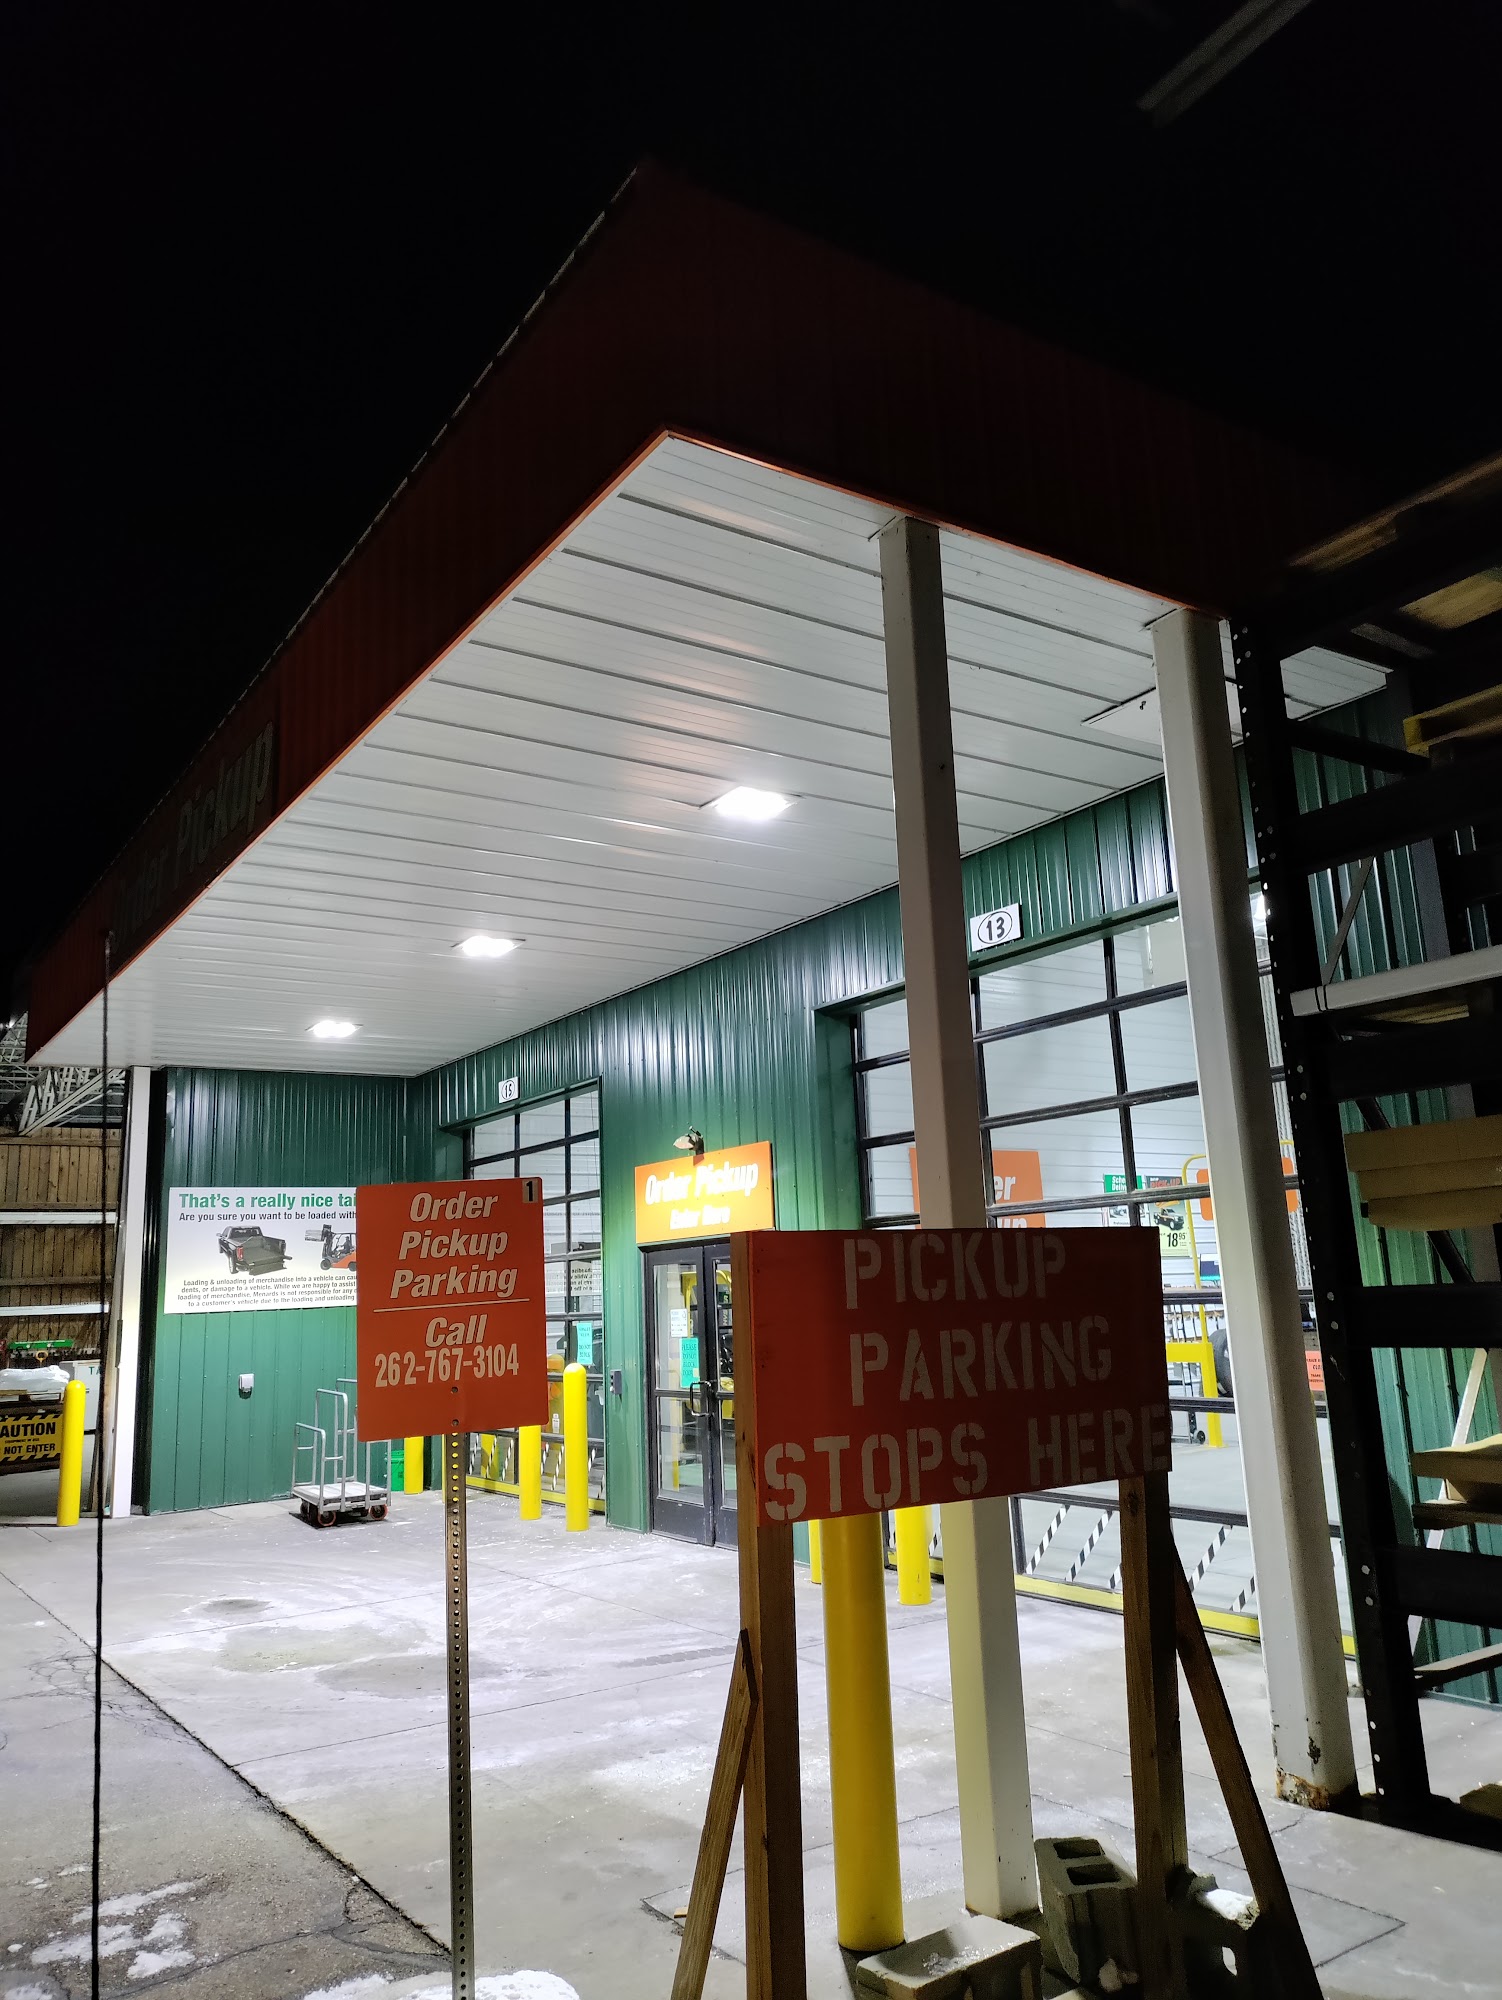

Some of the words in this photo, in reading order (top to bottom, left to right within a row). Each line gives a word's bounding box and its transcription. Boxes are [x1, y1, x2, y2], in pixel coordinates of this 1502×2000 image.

[986, 916, 1005, 941] 13
[525, 1181, 533, 1202] 1
[645, 1171, 692, 1205] Order
[695, 1161, 759, 1197] Pickup
[179, 1193, 230, 1208] That's
[236, 1196, 245, 1207] a
[251, 1193, 296, 1210] really
[301, 1193, 333, 1207] nice
[338, 1193, 357, 1207] tai
[179, 1213, 195, 1221] Are
[198, 1214, 214, 1222] you
[240, 1213, 256, 1222] you
[259, 1212, 281, 1220] want
[284, 1212, 292, 1220] to
[308, 1211, 336, 1219] loaded
[339, 1211, 357, 1219] with
[410, 1191, 499, 1222] Order
[398, 1228, 508, 1261] Pickup
[1167, 1233, 1178, 1247] 18
[390, 1265, 518, 1299] Parking
[844, 1231, 1066, 1309] PICKUP
[425, 1314, 488, 1348] Call
[375, 1343, 519, 1388] 262-767-3104
[849, 1314, 1113, 1407] PARKING
[0, 1422, 56, 1438] AUTION
[4, 1445, 23, 1454] NOT
[26, 1443, 55, 1453] ENTER
[764, 1422, 988, 1521] STOPS
[1027, 1404, 1171, 1486] HERE
